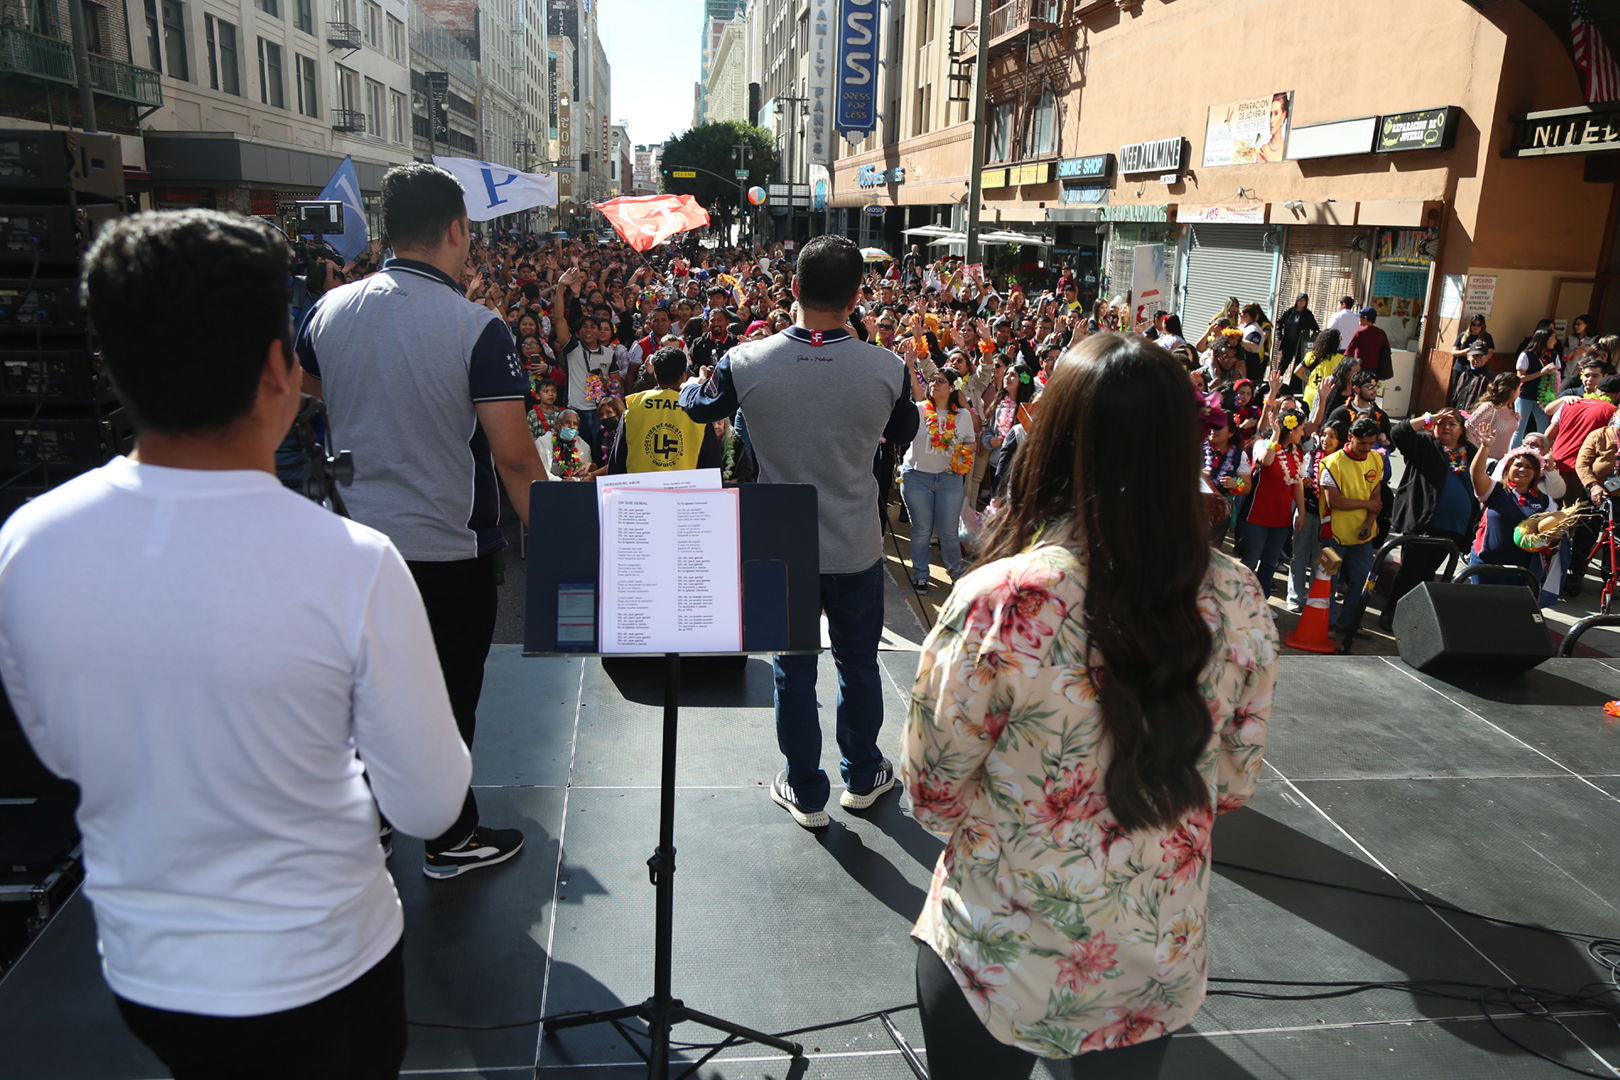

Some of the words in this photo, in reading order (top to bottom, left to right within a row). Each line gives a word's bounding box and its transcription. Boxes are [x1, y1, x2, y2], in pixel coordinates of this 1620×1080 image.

[843, 92, 870, 100] DRESS
[848, 102, 865, 110] FOR
[1238, 100, 1269, 111] REPARACION
[845, 111, 867, 119] LESS
[1238, 112, 1245, 120] DE
[1246, 109, 1266, 119] JOYERIA
[813, 87, 824, 154] PANTS
[1391, 120, 1428, 133] REPARACION
[1428, 118, 1437, 129] DE
[1399, 130, 1424, 142] JOYERIA
[1059, 160, 1081, 176] SMOKE
[1083, 157, 1103, 175] SHOP
[645, 399, 684, 411] STAF
[652, 459, 676, 468] UNIFORCE
